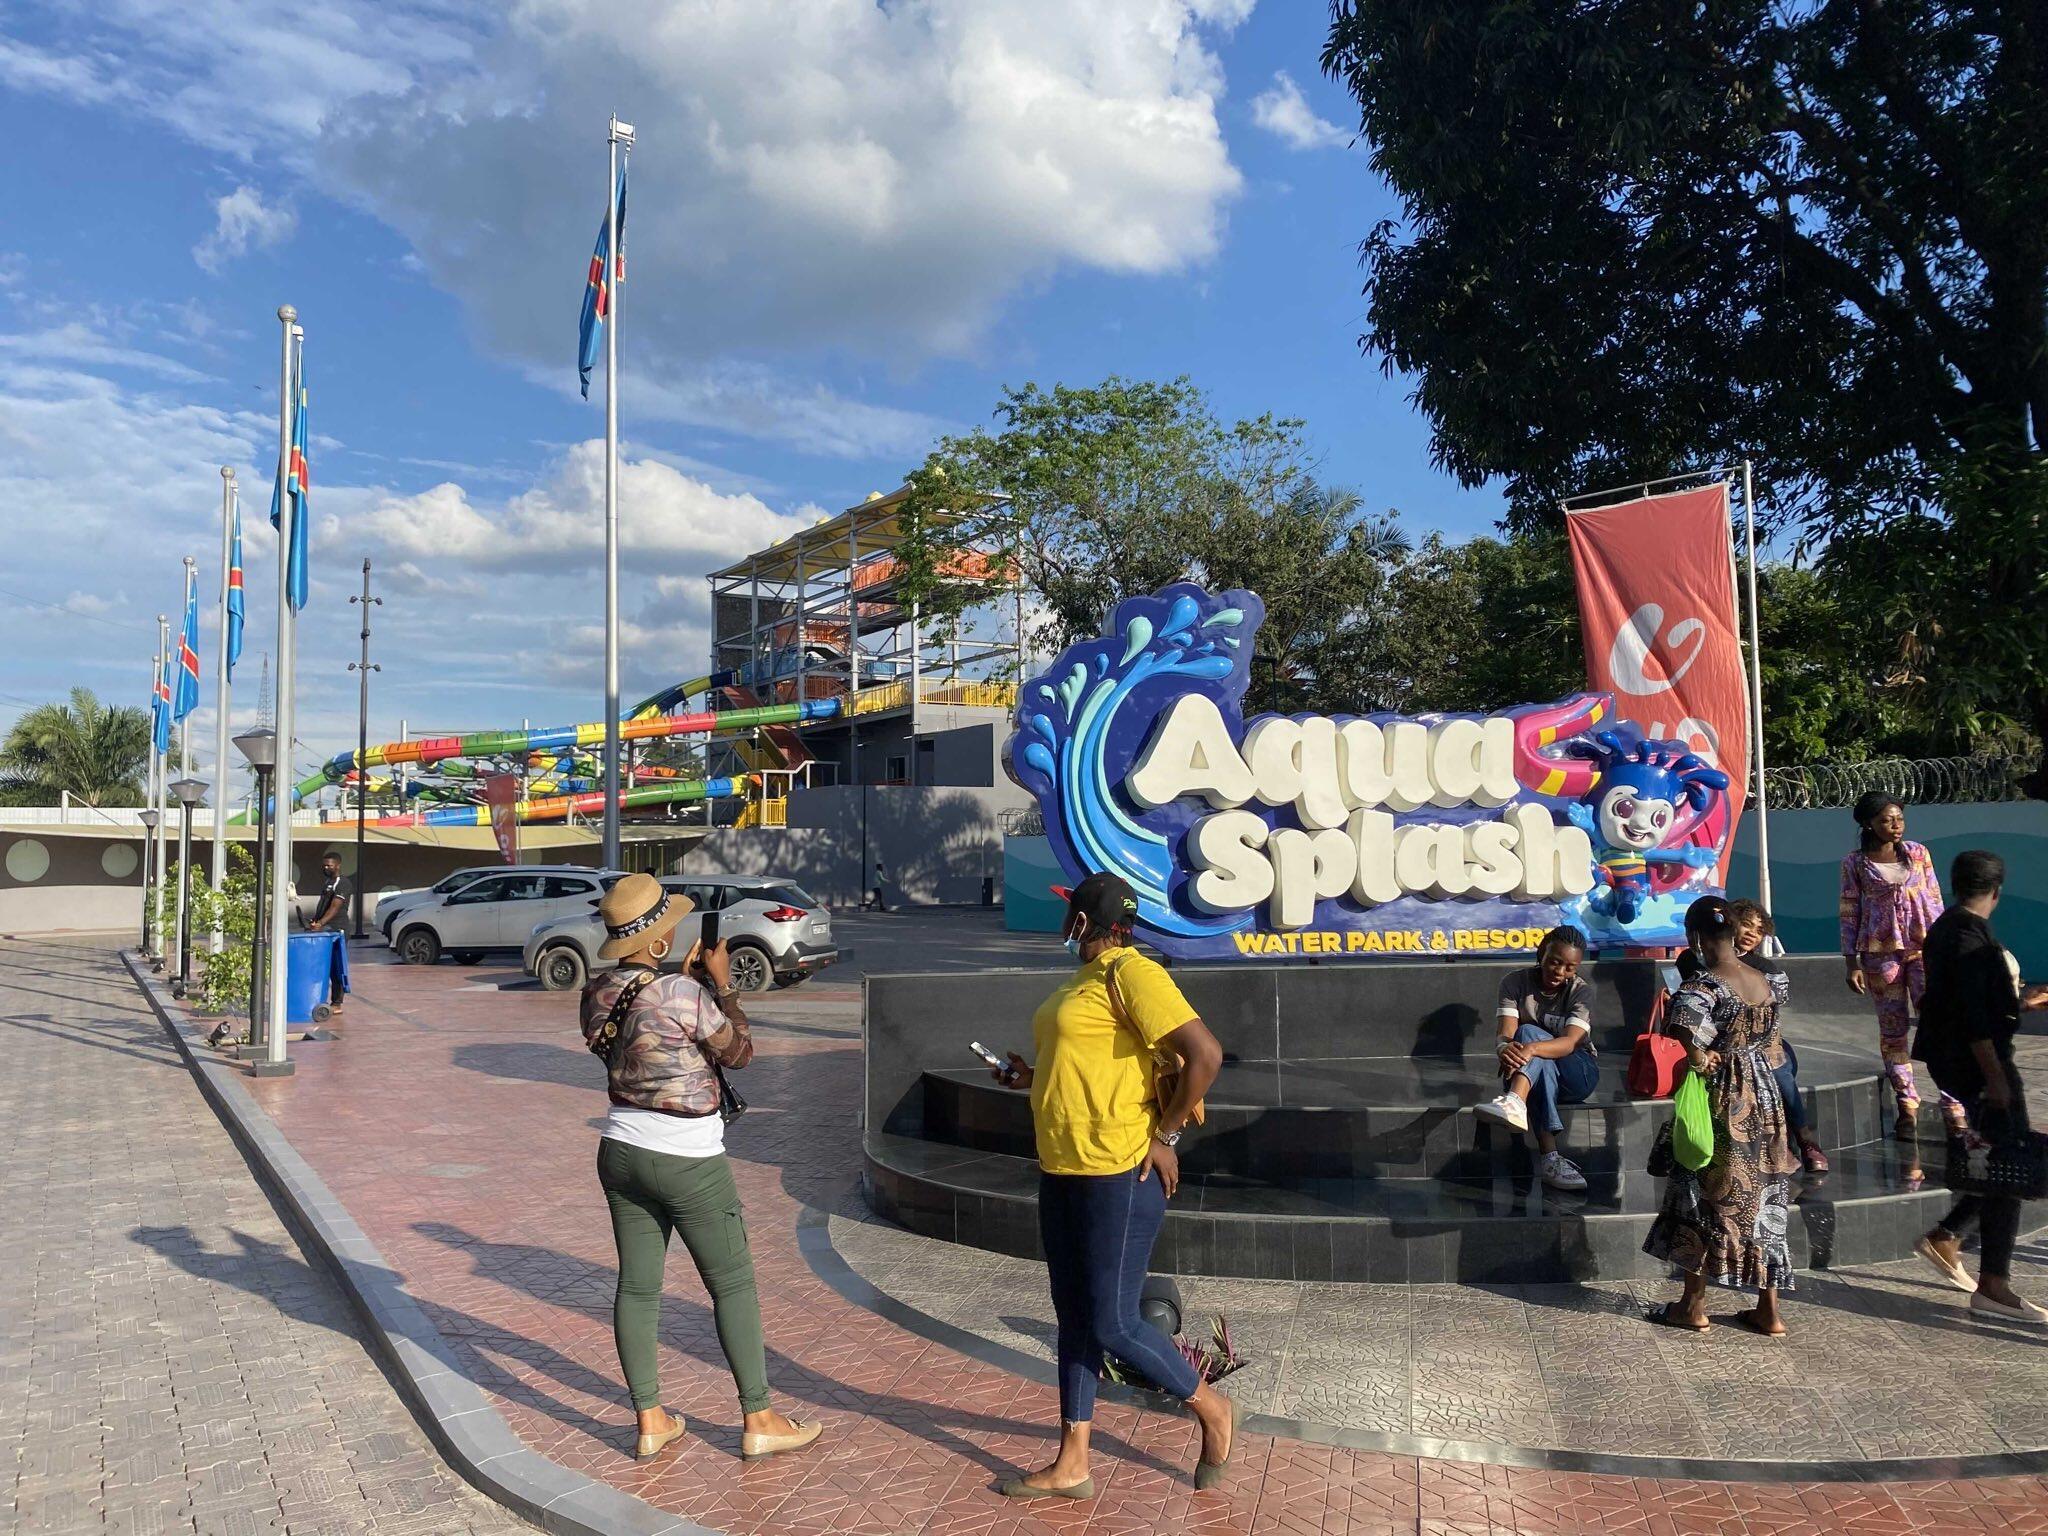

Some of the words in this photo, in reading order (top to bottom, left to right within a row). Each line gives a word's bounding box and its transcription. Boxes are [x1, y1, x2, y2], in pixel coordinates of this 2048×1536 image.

[1127, 693, 1521, 829] Aqua
[1190, 802, 1596, 927] Splash
[1232, 931, 1342, 954] WATER
[1346, 930, 1424, 952] PARK
[1429, 930, 1448, 950] &
[1454, 927, 1555, 950] RESOR
